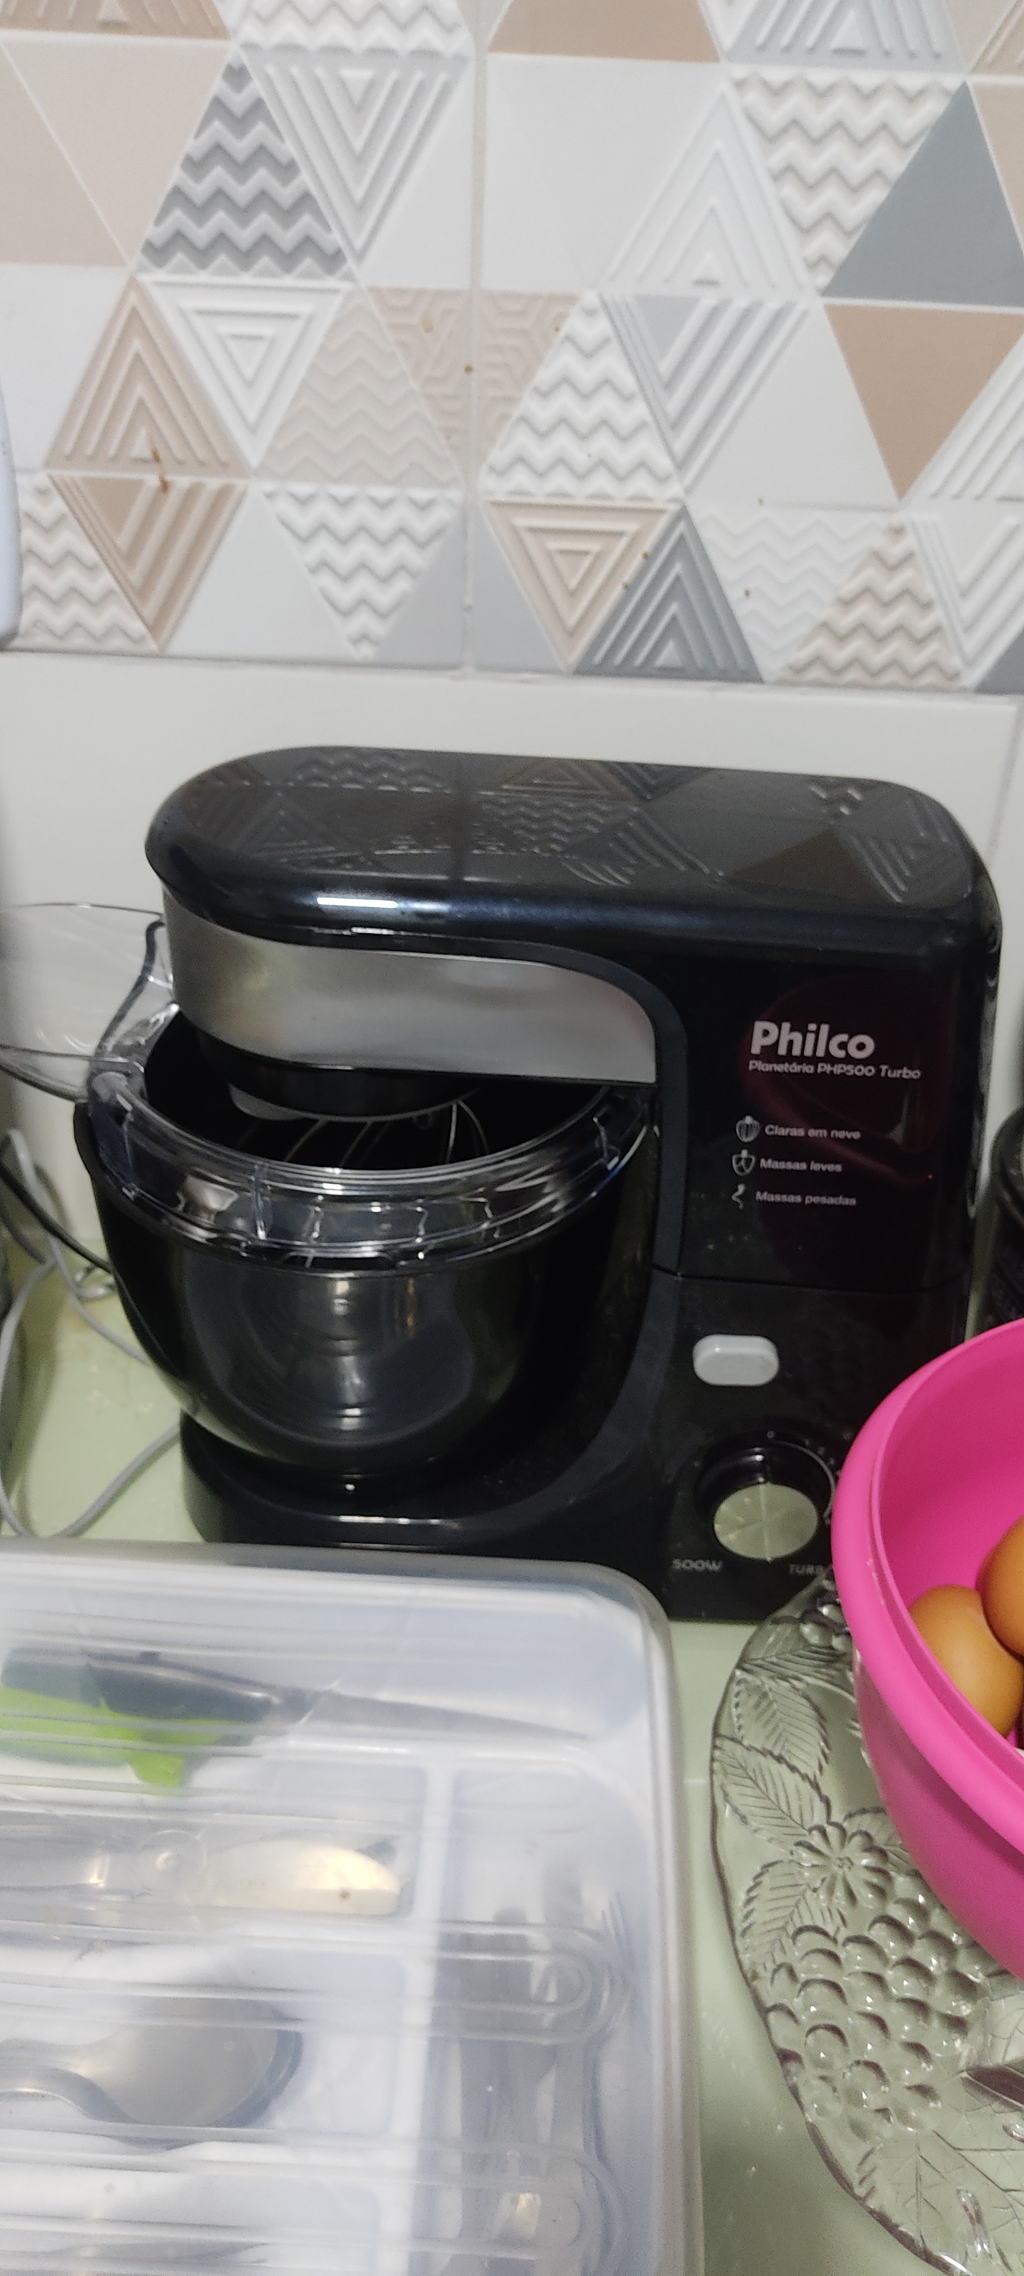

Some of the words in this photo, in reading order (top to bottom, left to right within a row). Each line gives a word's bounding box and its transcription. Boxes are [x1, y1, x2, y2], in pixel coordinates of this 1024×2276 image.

[751, 1020, 876, 1059] Philco
[749, 1060, 815, 1074] Planetária
[817, 1062, 876, 1077] PHP500
[879, 1064, 922, 1080] Turbo
[764, 1124, 805, 1137] Claras
[807, 1128, 828, 1138] em
[830, 1130, 861, 1140] neve
[760, 1158, 807, 1171] Massas
[810, 1161, 842, 1173] leves
[755, 1191, 802, 1204] Massas
[804, 1195, 857, 1206] pesadas
[672, 1558, 723, 1572] 500W
